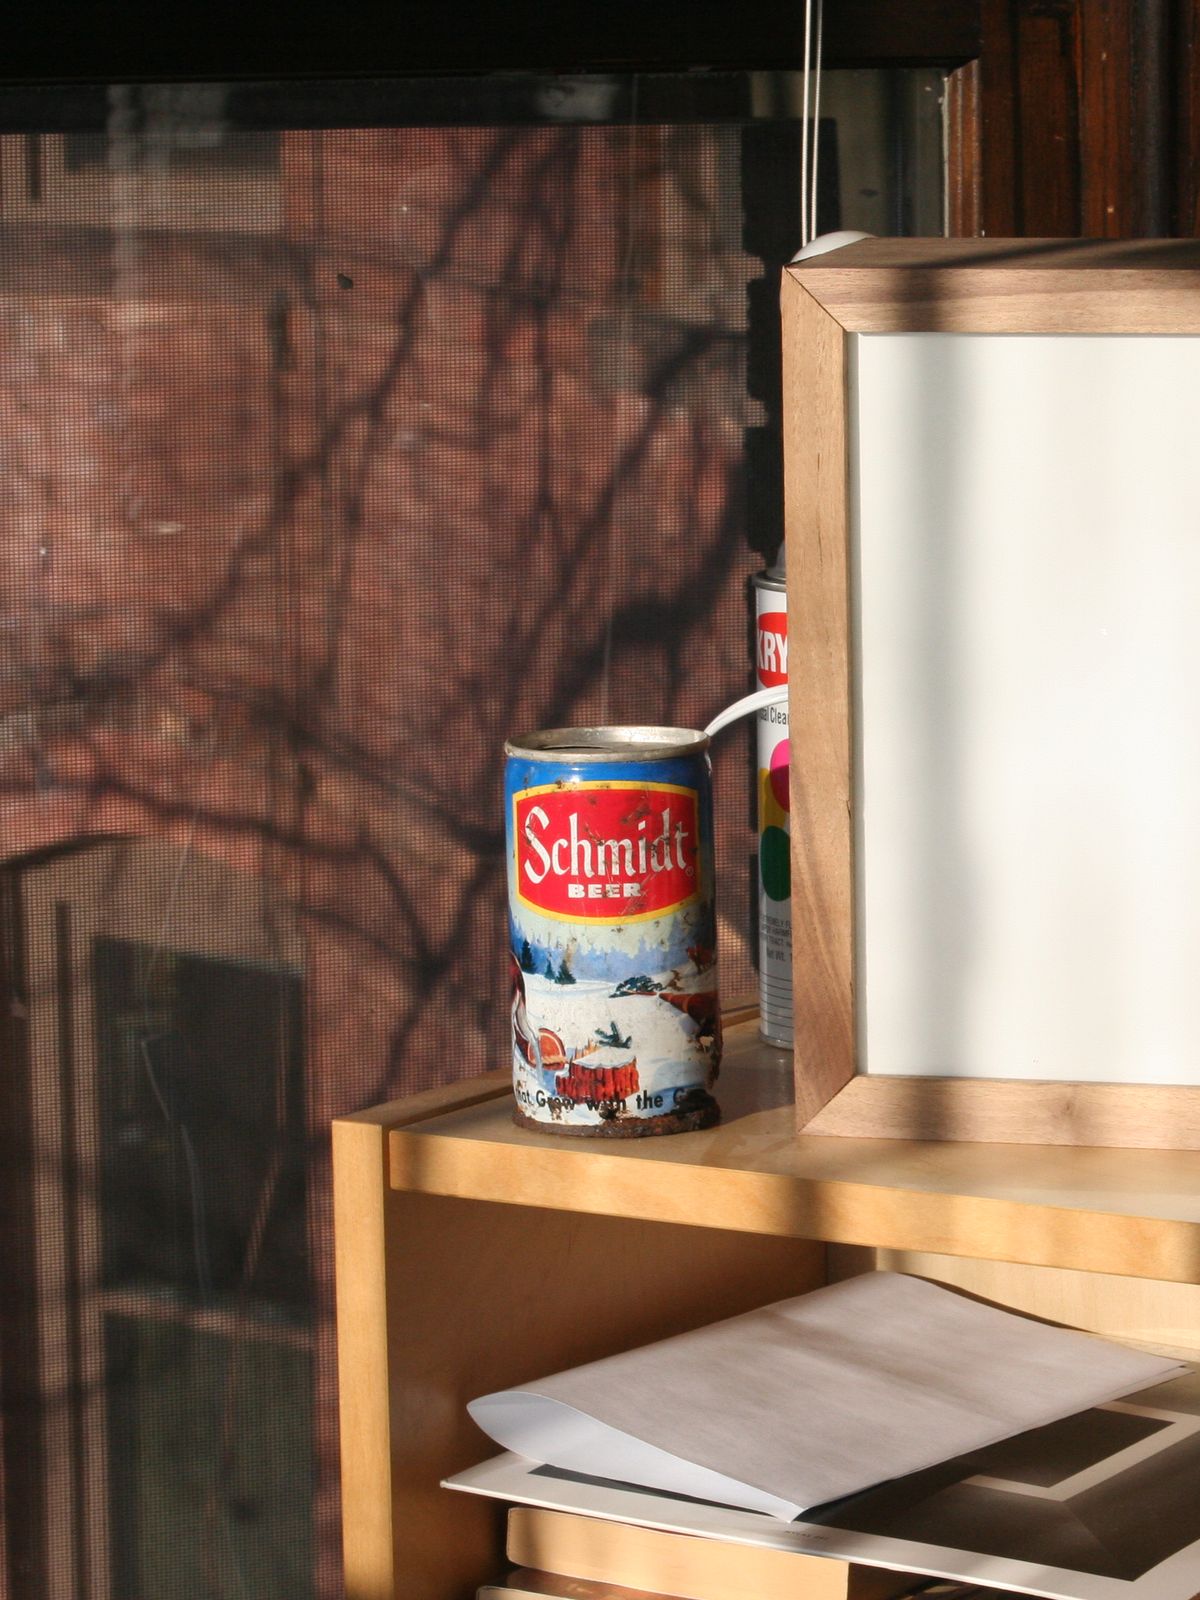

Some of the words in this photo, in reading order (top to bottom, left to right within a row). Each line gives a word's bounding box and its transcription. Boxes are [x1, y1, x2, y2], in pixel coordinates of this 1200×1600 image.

[524, 806, 688, 884] Schmidt
[568, 883, 642, 898] BEER
[636, 1089, 663, 1110] the
